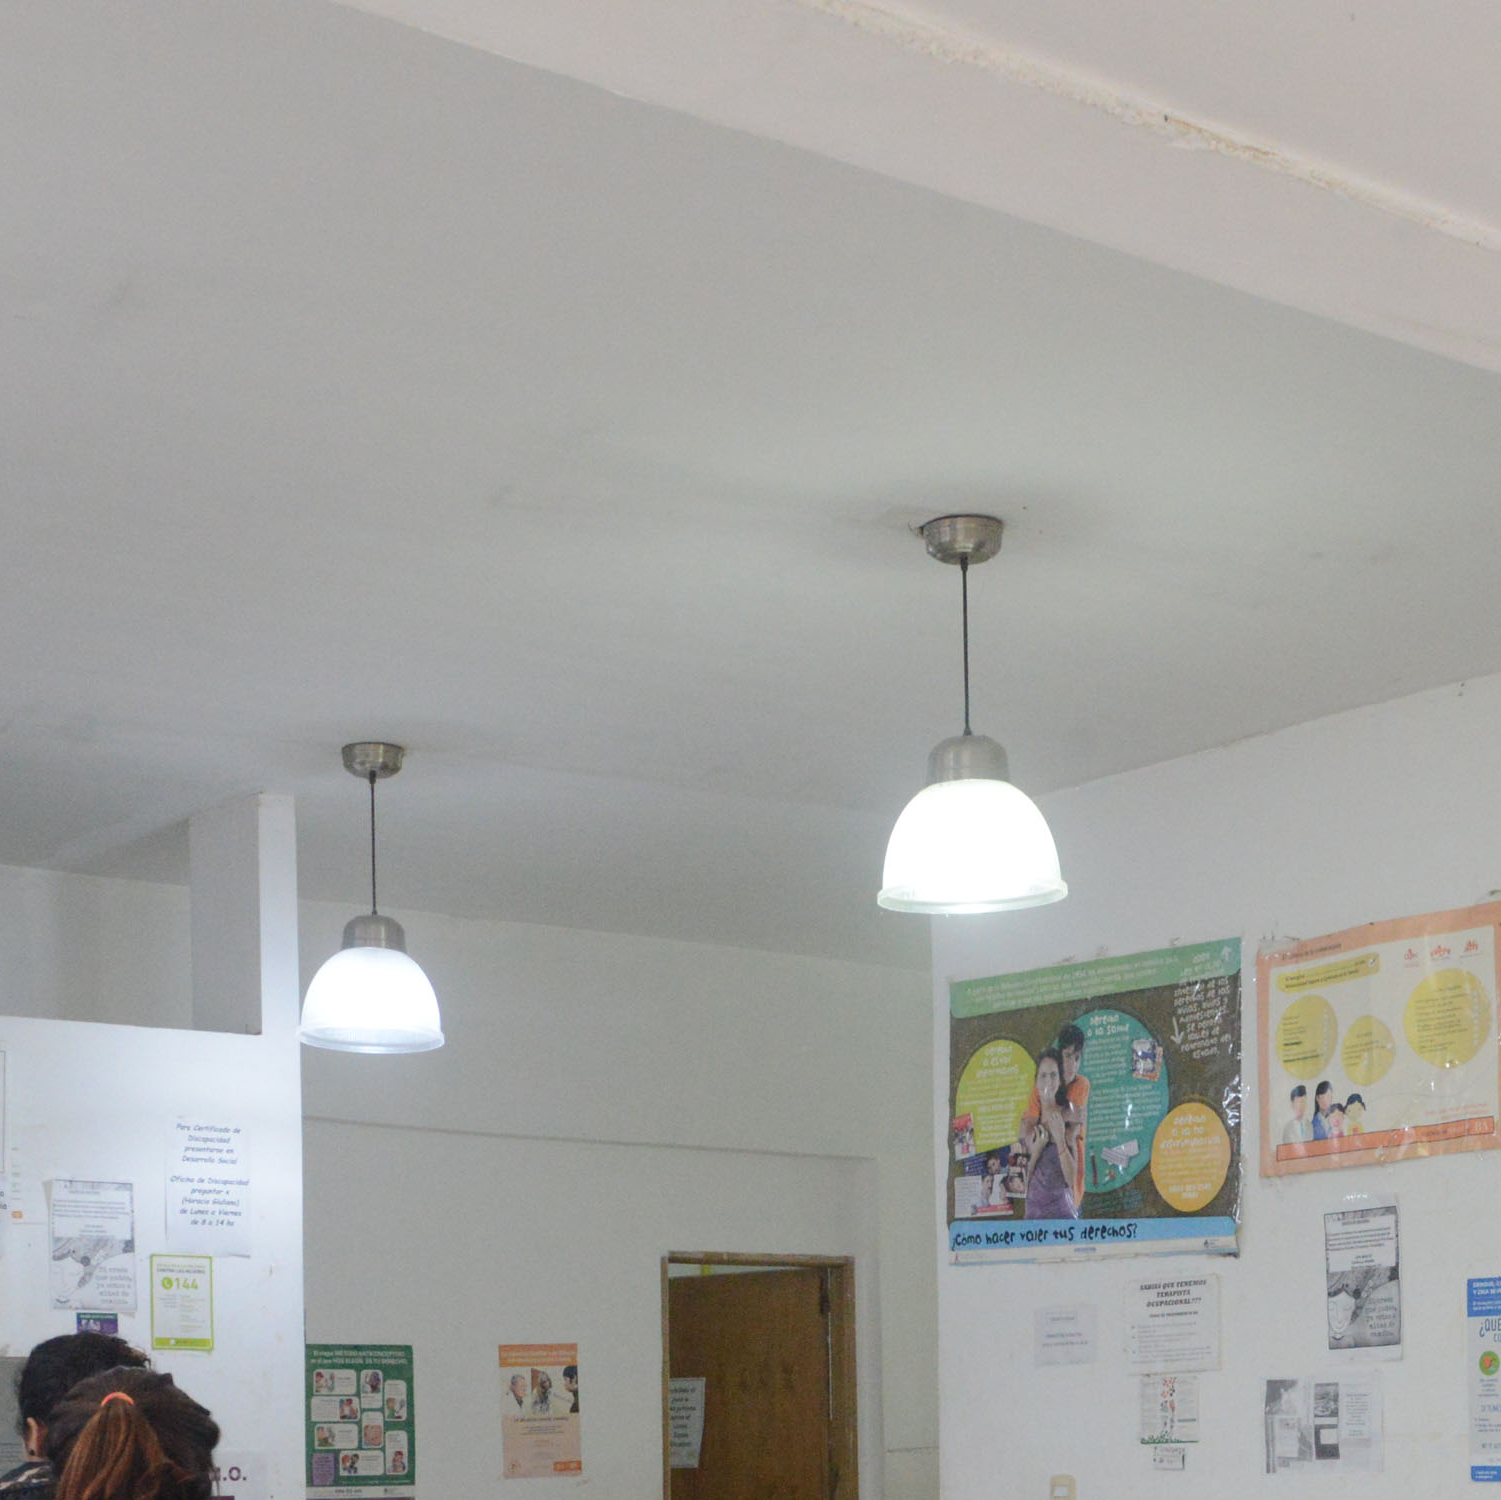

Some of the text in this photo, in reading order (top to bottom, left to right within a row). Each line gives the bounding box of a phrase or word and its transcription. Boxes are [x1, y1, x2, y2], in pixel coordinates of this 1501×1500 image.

[193, 1125, 230, 1133] Certificado
[188, 1134, 231, 1144] Discapacidad
[182, 1155, 215, 1163] Desarrollo
[952, 1222, 1138, 1251] ¿Cómo hacer valer tus derechos?
[175, 1277, 199, 1290] 144
[1163, 1282, 1176, 1290] QUE
[1176, 1279, 1207, 1289] TENEMOS
[1156, 1289, 1191, 1298] TERAPISTA
